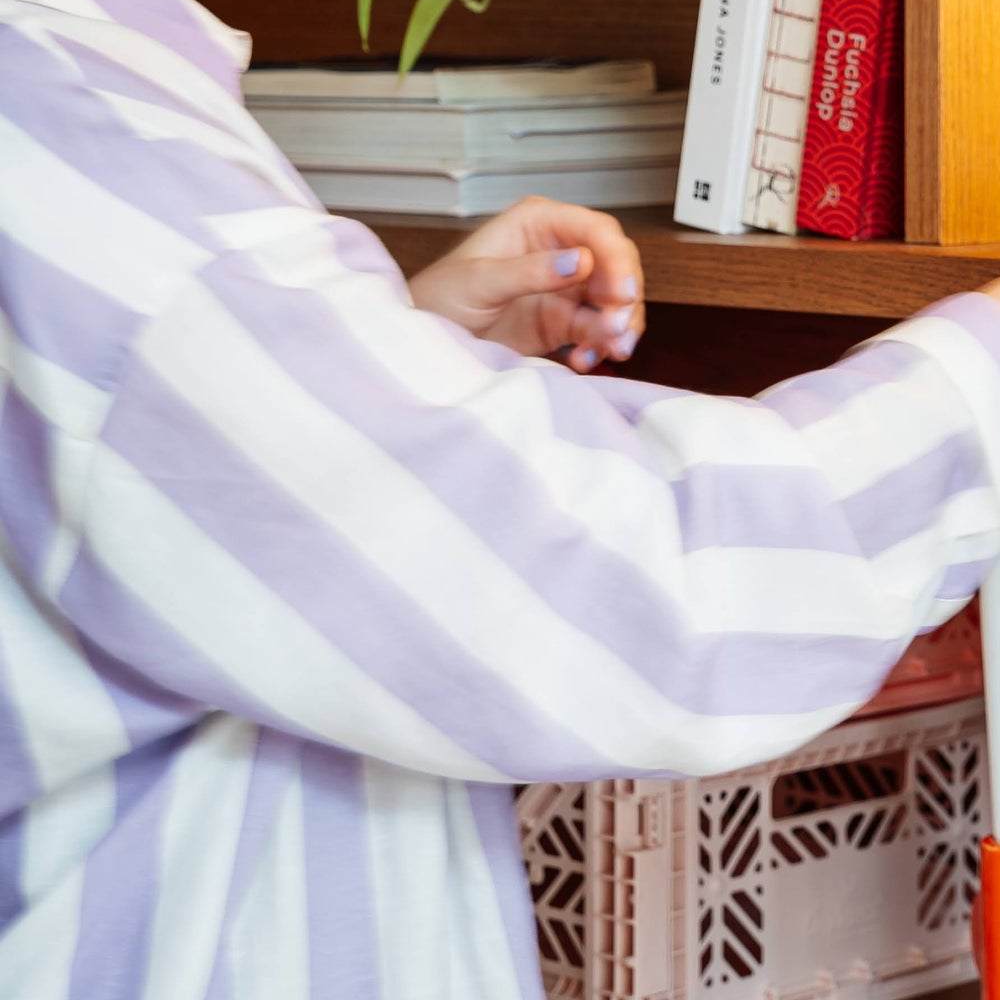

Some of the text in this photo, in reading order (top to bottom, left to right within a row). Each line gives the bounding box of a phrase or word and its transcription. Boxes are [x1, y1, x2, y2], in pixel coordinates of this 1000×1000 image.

[710, 25, 726, 86] JONES
[815, 29, 845, 121] Dunlop
[838, 33, 866, 132] Fuchsia
